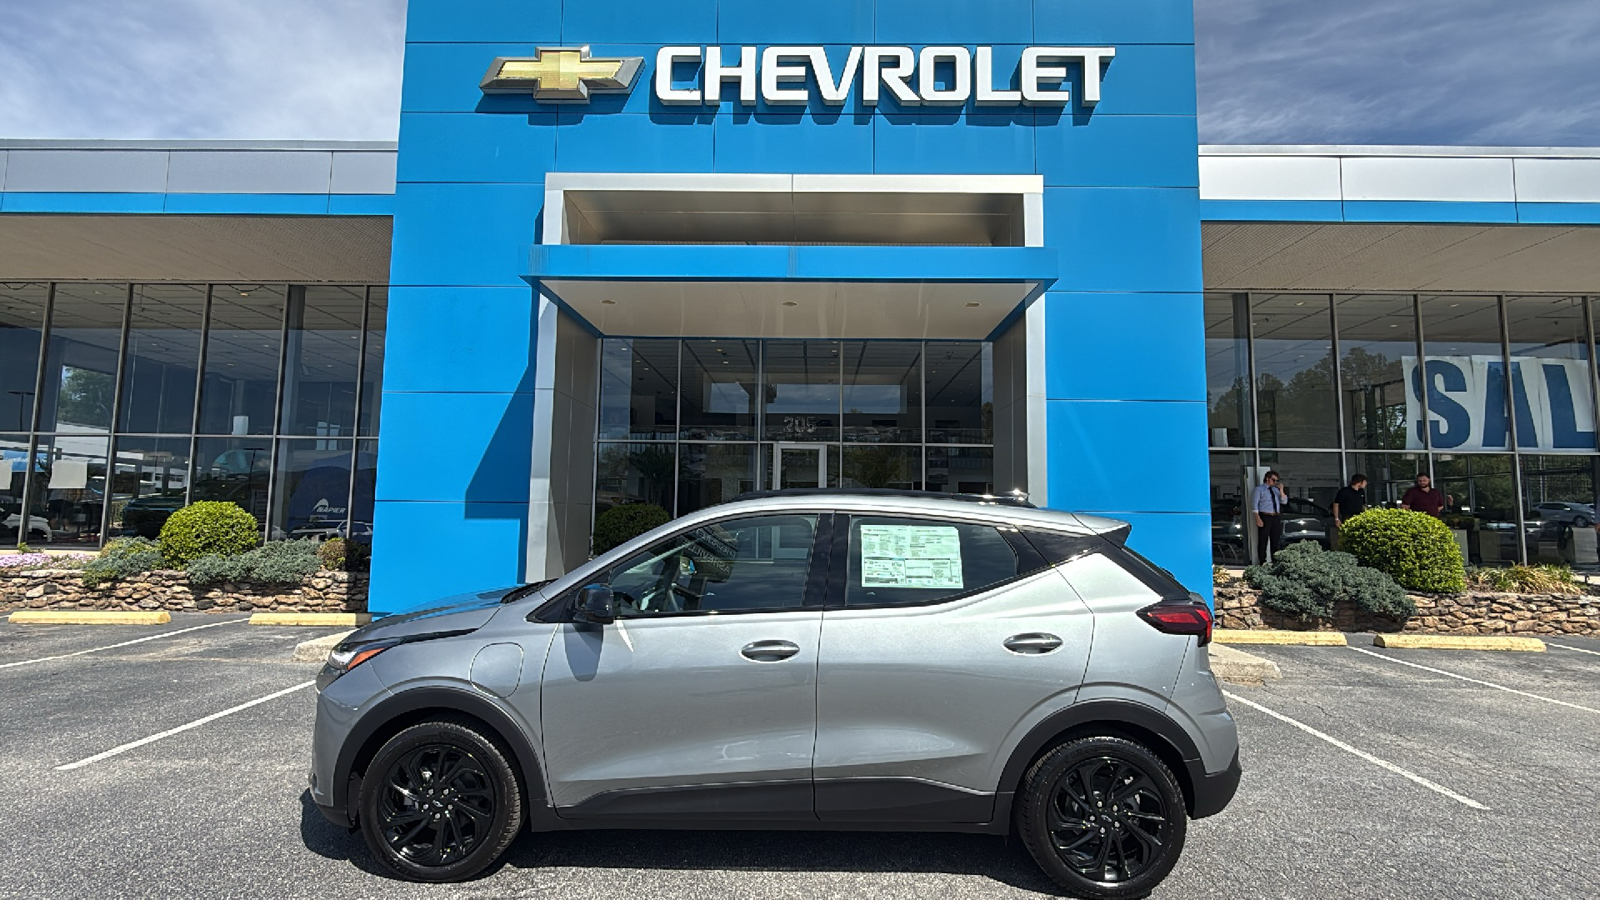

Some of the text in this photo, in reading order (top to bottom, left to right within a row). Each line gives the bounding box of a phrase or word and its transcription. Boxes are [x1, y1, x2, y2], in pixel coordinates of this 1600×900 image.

[655, 46, 1117, 106] CHEVROLET
[783, 416, 817, 433] 205
[316, 506, 346, 514] NAPIER
